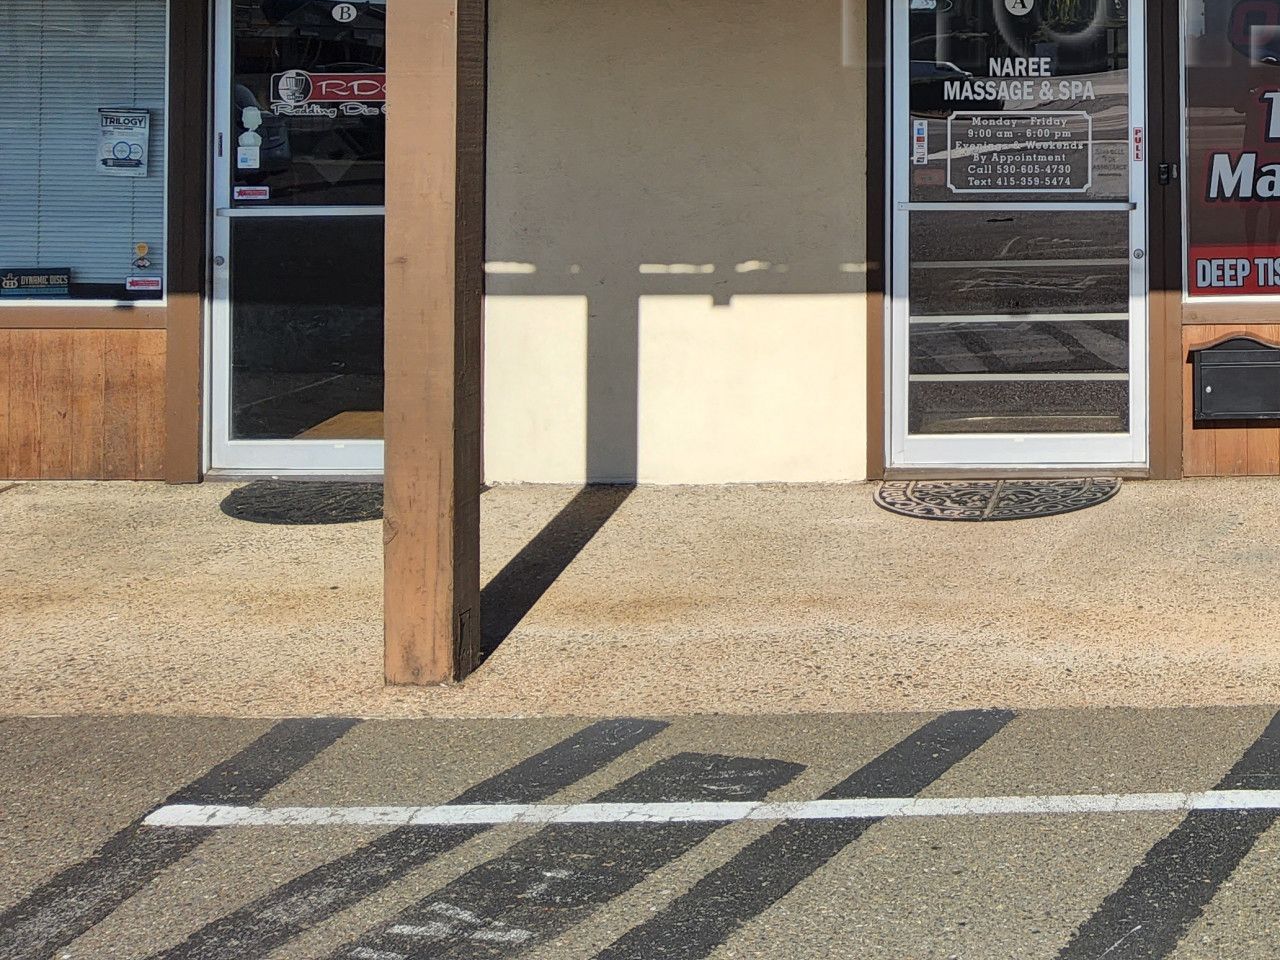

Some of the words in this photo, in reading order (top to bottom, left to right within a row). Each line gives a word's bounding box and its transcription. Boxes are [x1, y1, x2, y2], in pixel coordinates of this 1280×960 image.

[339, 5, 352, 20] B
[988, 57, 1052, 77] NAREE
[316, 80, 386, 96] RD
[943, 80, 1035, 101] MASSAGE
[1038, 80, 1054, 101] &
[1058, 80, 1096, 101] SPA
[270, 102, 337, 119] Redding
[103, 116, 144, 126] TRILOGY
[971, 116, 1018, 127] Monday
[1030, 116, 1068, 128] Friday
[968, 129, 992, 138] 9:00
[996, 130, 1013, 138] am
[1026, 129, 1050, 138] 6:00
[1054, 130, 1071, 140] pm
[955, 141, 1010, 152] Evenings
[1025, 140, 1084, 150] Weekends
[1134, 129, 1142, 160] PULL
[972, 154, 987, 164] By
[991, 154, 1066, 164] Appointment
[968, 164, 992, 174] Call
[996, 164, 1071, 174] 530-605-4730
[968, 176, 991, 186] Text
[996, 176, 1071, 186] 415-359-5474
[1197, 257, 1252, 288] DEEP
